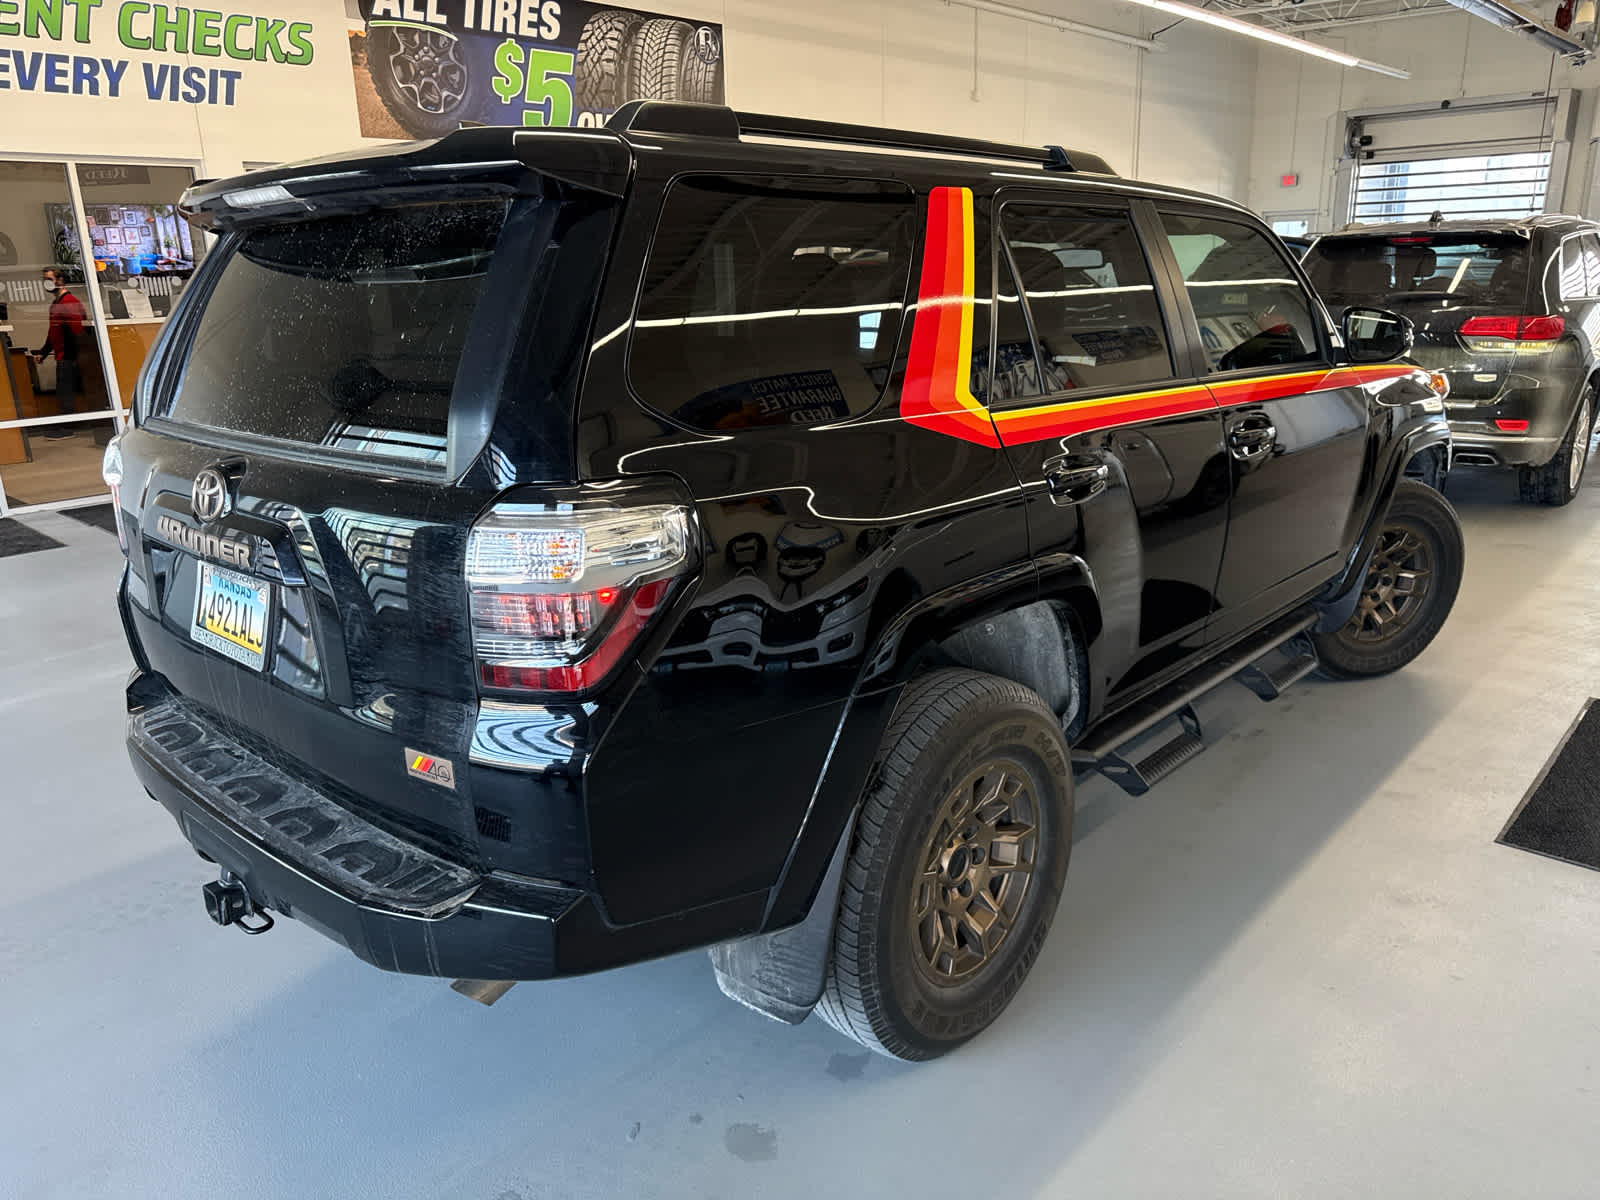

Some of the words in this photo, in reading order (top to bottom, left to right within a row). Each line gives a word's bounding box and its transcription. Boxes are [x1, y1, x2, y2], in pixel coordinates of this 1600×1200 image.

[117, 0, 314, 65] CHECKS
[464, 0, 561, 41] TIRES
[142, 62, 242, 106] VISIT
[157, 515, 250, 568] 4RUNNER
